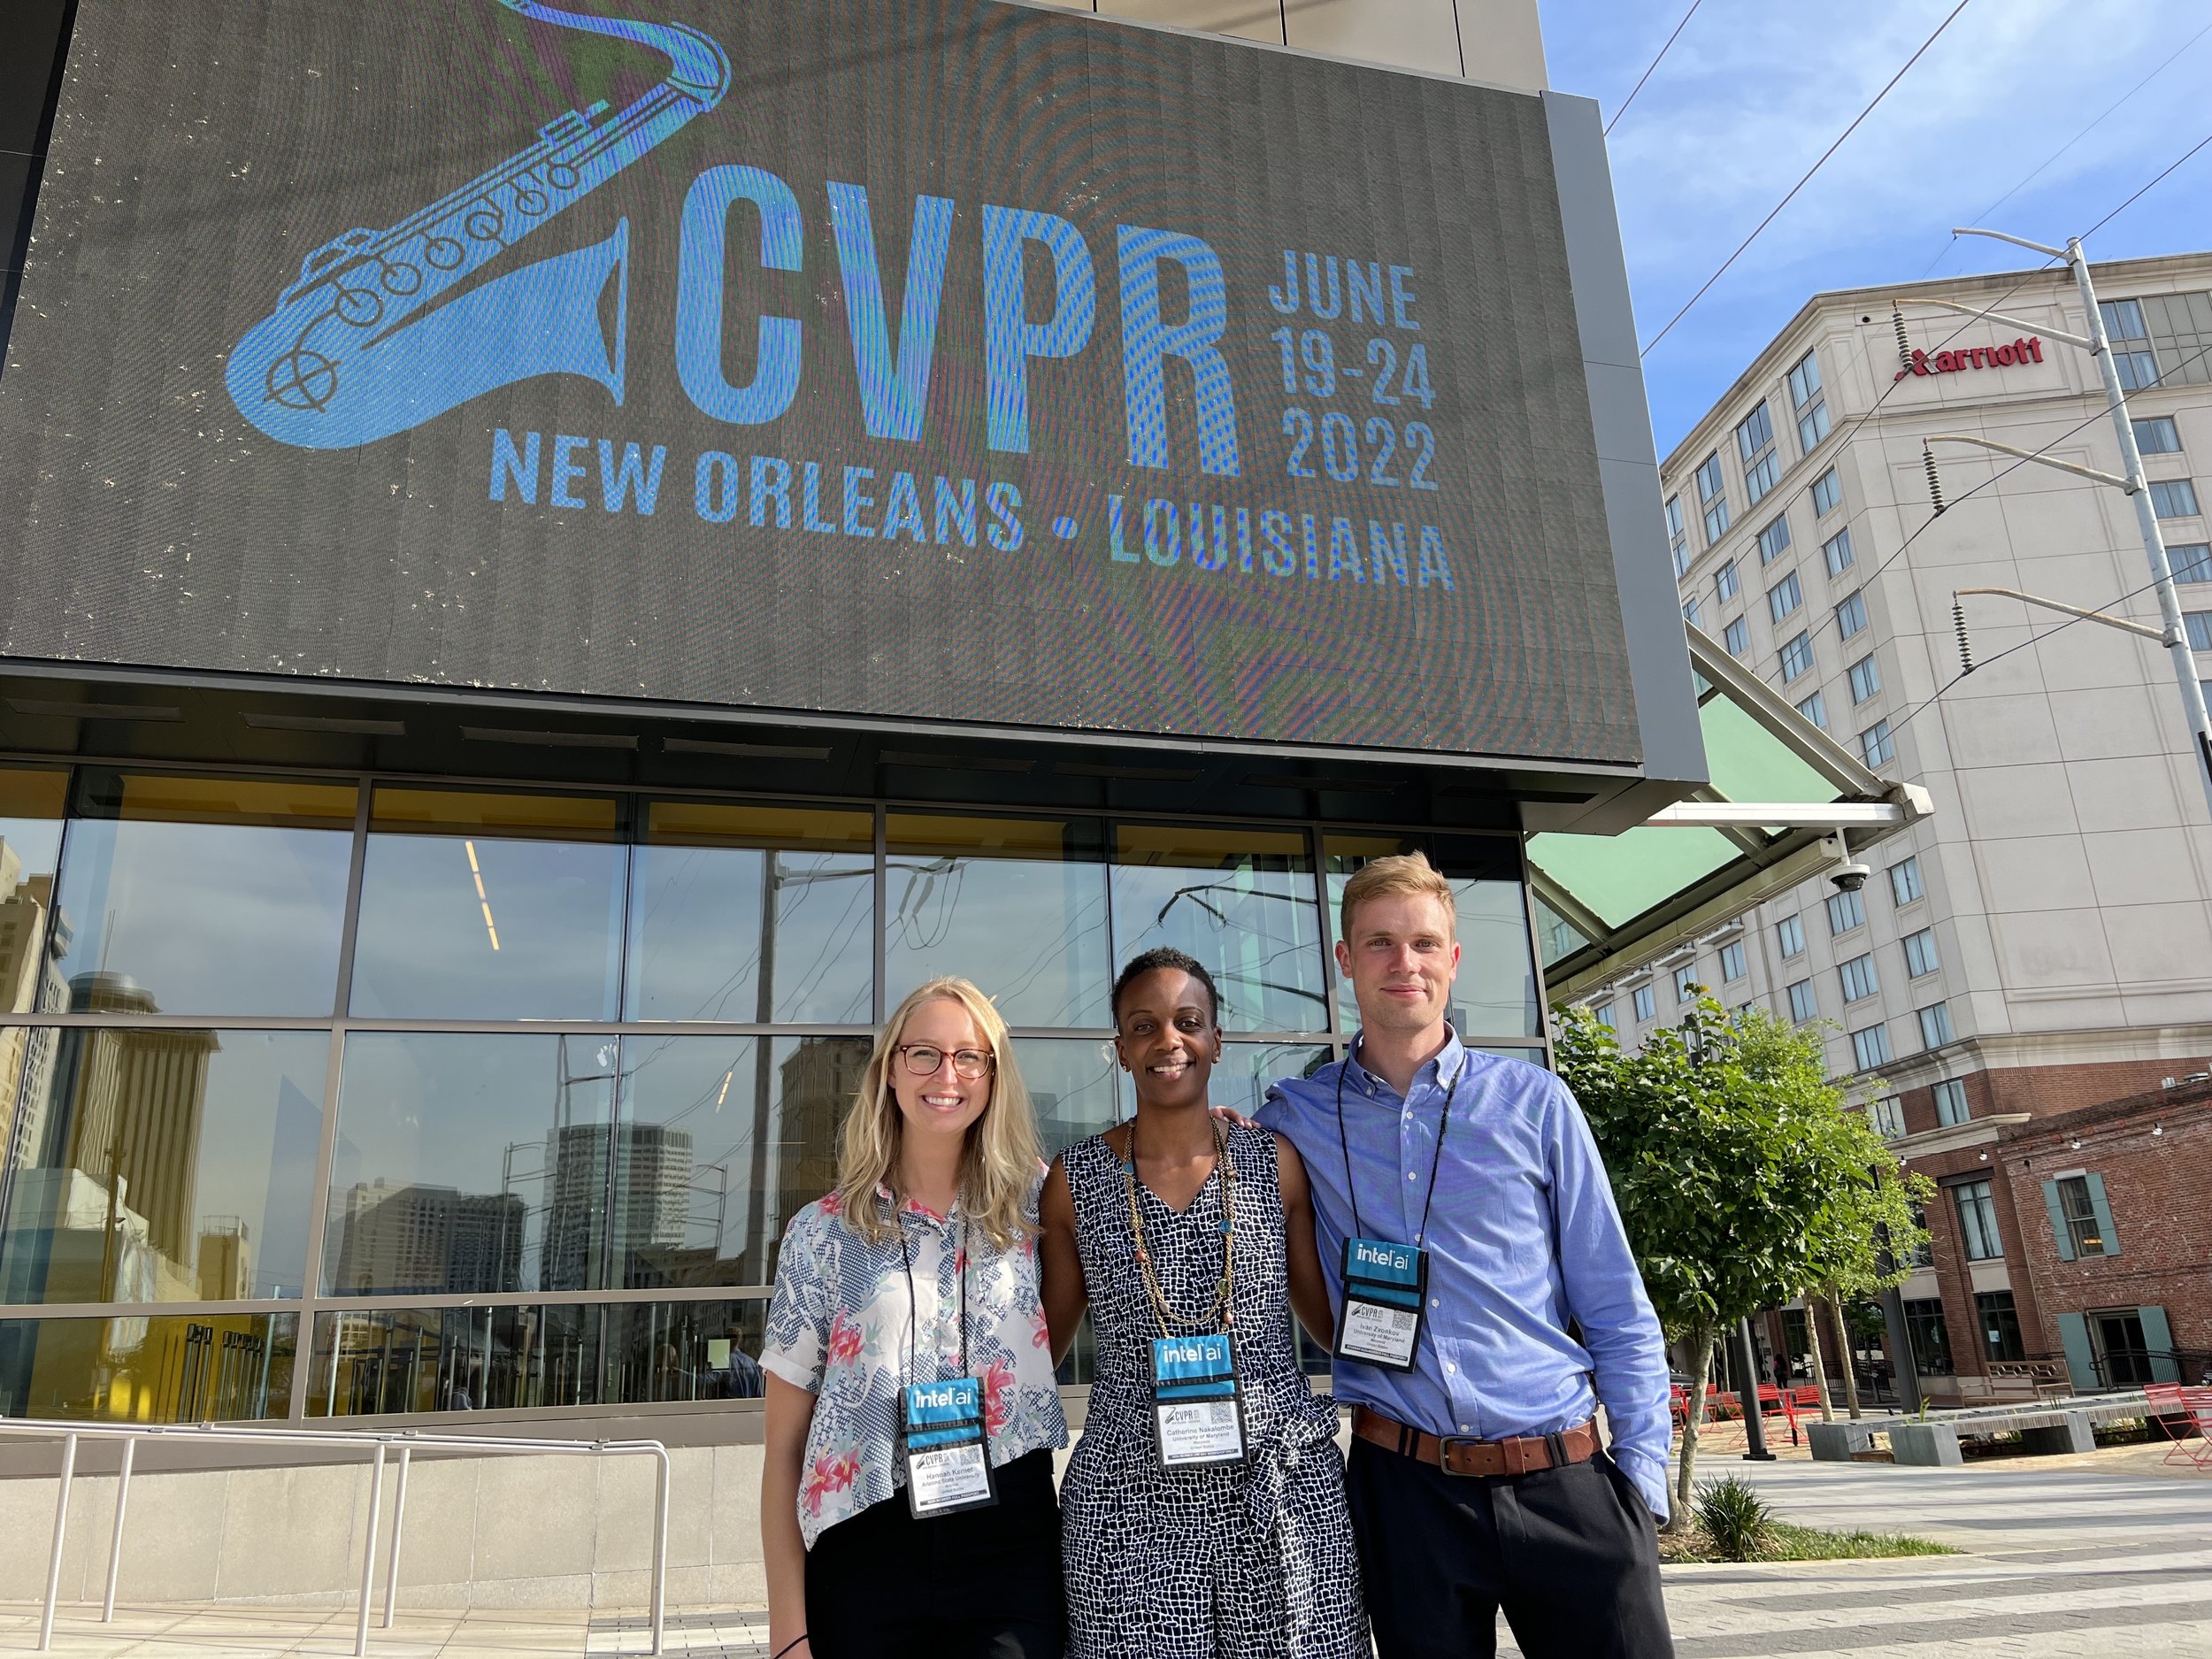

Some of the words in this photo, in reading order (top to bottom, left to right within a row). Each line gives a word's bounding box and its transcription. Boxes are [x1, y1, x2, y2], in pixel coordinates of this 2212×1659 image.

[1269, 250, 1420, 331] JUNE
[675, 164, 1240, 477] CVPR
[1271, 328, 1436, 410] 19-24
[1893, 336, 2044, 380] Marriott
[1281, 407, 1439, 491] 2022
[488, 427, 667, 516] NEW
[694, 449, 1025, 554] ORLEANS
[1108, 494, 1455, 591] LOUISIANA
[1357, 1243, 1393, 1266] intel
[1394, 1255, 1409, 1271] ai
[1361, 1306, 1378, 1317] CVPR
[1163, 1344, 1203, 1363] intel
[1206, 1344, 1222, 1360] ai
[916, 1388, 953, 1409] intel
[956, 1388, 972, 1405] ai
[1175, 1409, 1194, 1421] CVPR
[925, 1453, 943, 1465] CVPR
